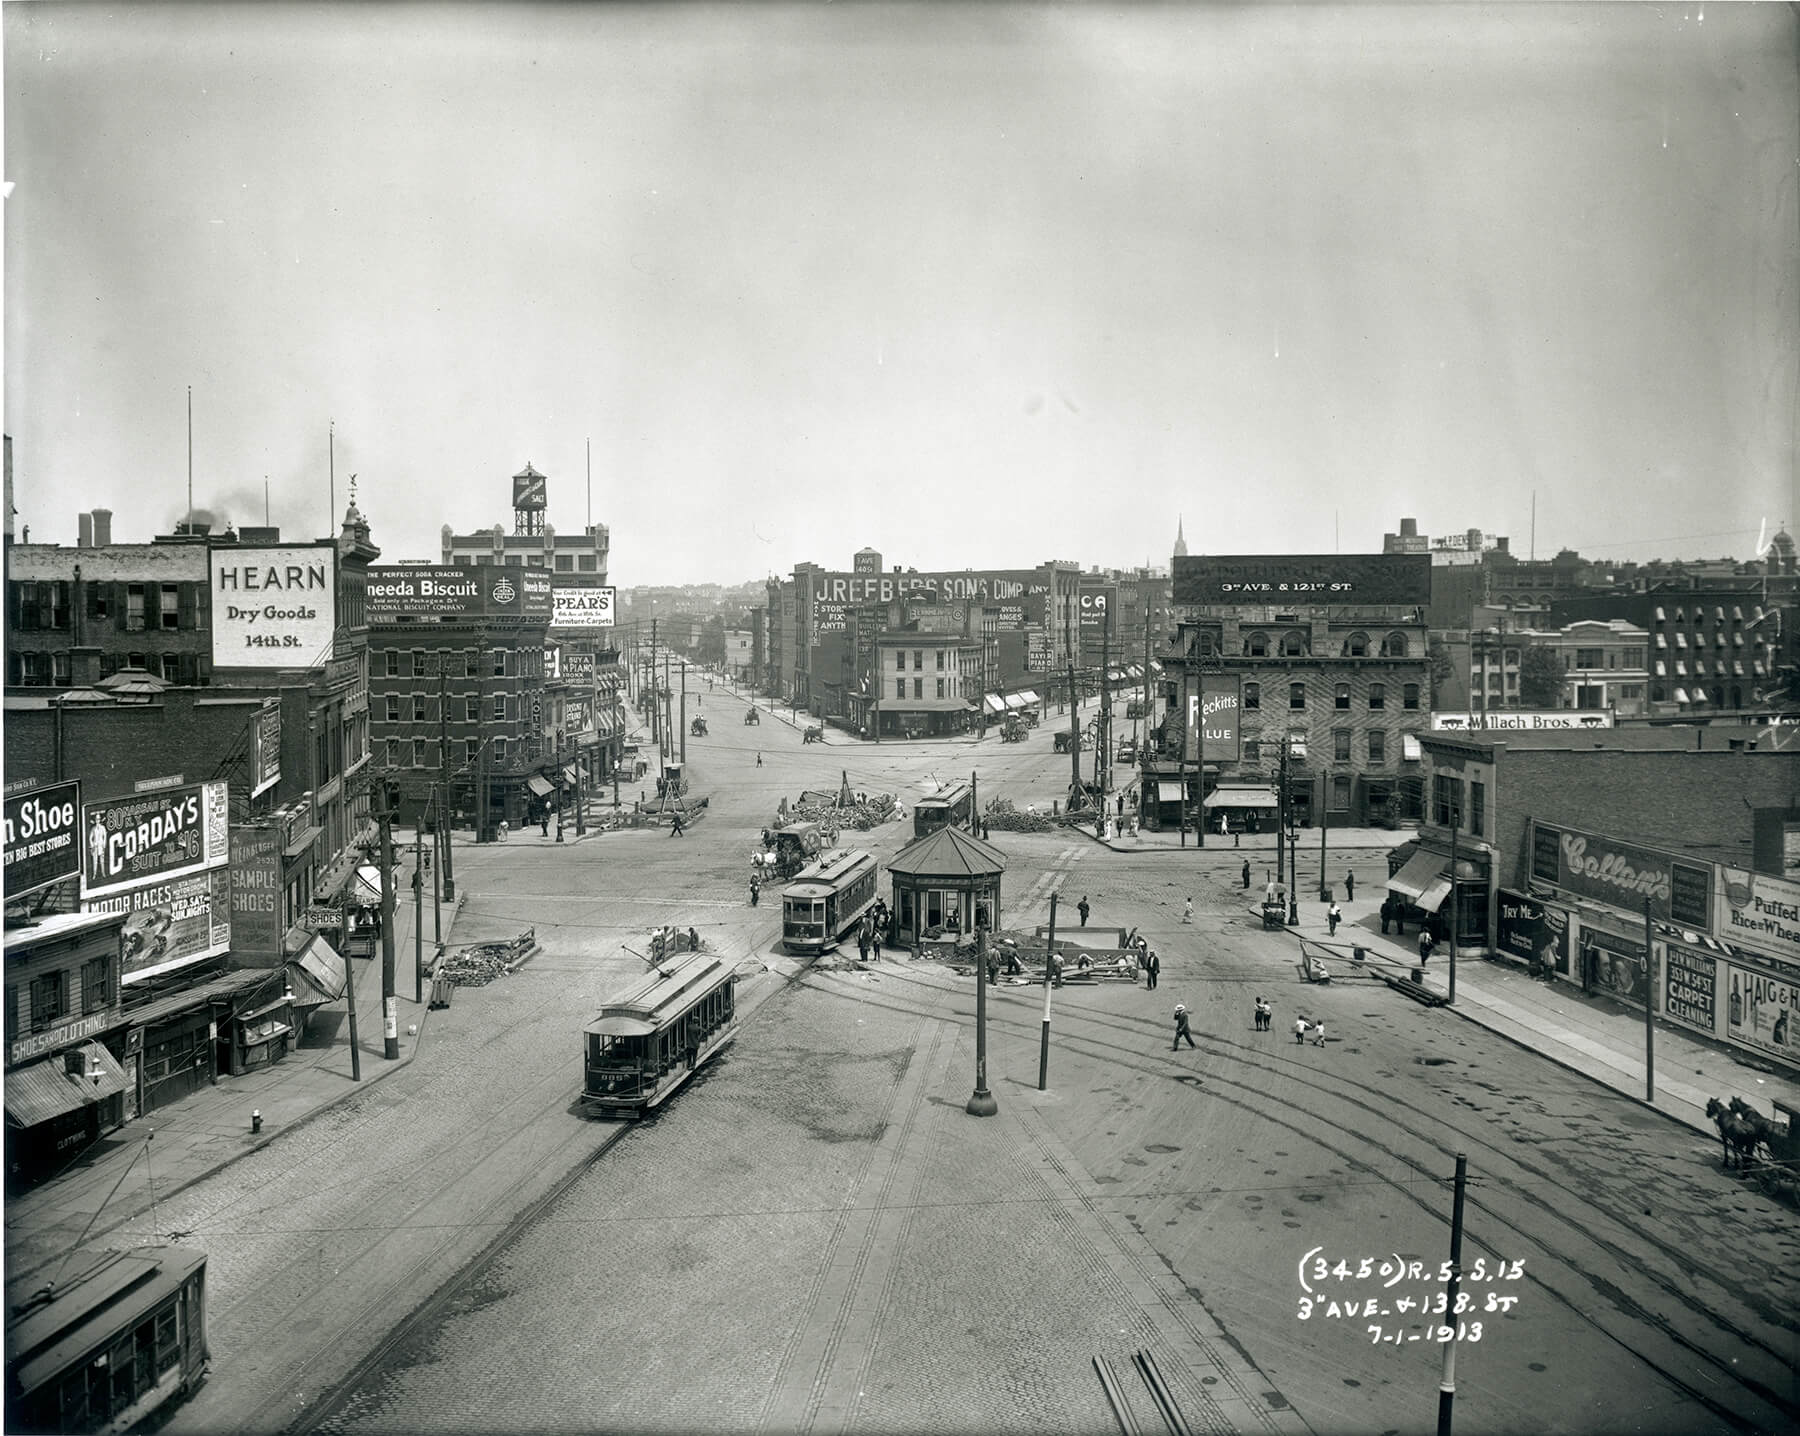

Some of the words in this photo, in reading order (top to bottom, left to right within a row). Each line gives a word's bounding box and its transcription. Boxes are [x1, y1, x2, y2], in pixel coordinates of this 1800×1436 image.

[220, 565, 326, 590] HEARN
[367, 580, 414, 596] needa
[421, 580, 478, 596] Biscuit
[1242, 583, 1273, 591] AVE.
[1279, 583, 1289, 591] &
[1329, 583, 1353, 591] ST.
[552, 596, 609, 610] PEAR'S
[227, 605, 260, 624] Dry
[263, 604, 317, 619] Goods
[245, 634, 281, 647] 14th
[282, 634, 303, 647] St.
[570, 663, 593, 672] PIANO
[532, 695, 541, 739] HOTEL
[1532, 716, 1573, 729] Bros.
[20, 797, 74, 839] Shoe
[109, 795, 198, 875] CORDAY'S
[15, 846, 28, 862] BIG
[28, 840, 46, 857] BEST
[46, 832, 72, 852] STORES
[132, 851, 162, 872] SUIT
[231, 870, 276, 889] SAMPLE
[91, 895, 131, 913] MOTOR
[134, 885, 172, 911] RACES
[232, 893, 275, 912] SHOES
[1754, 896, 1799, 922] Puffed
[311, 913, 342, 924] SHOES
[1731, 909, 1757, 930] Rice
[1668, 981, 1713, 1011] CARPET
[1743, 972, 1777, 1021] HAIG
[1779, 987, 1788, 1004] &
[1668, 997, 1713, 1028] CLEANING
[12, 1034, 45, 1061] SHOES
